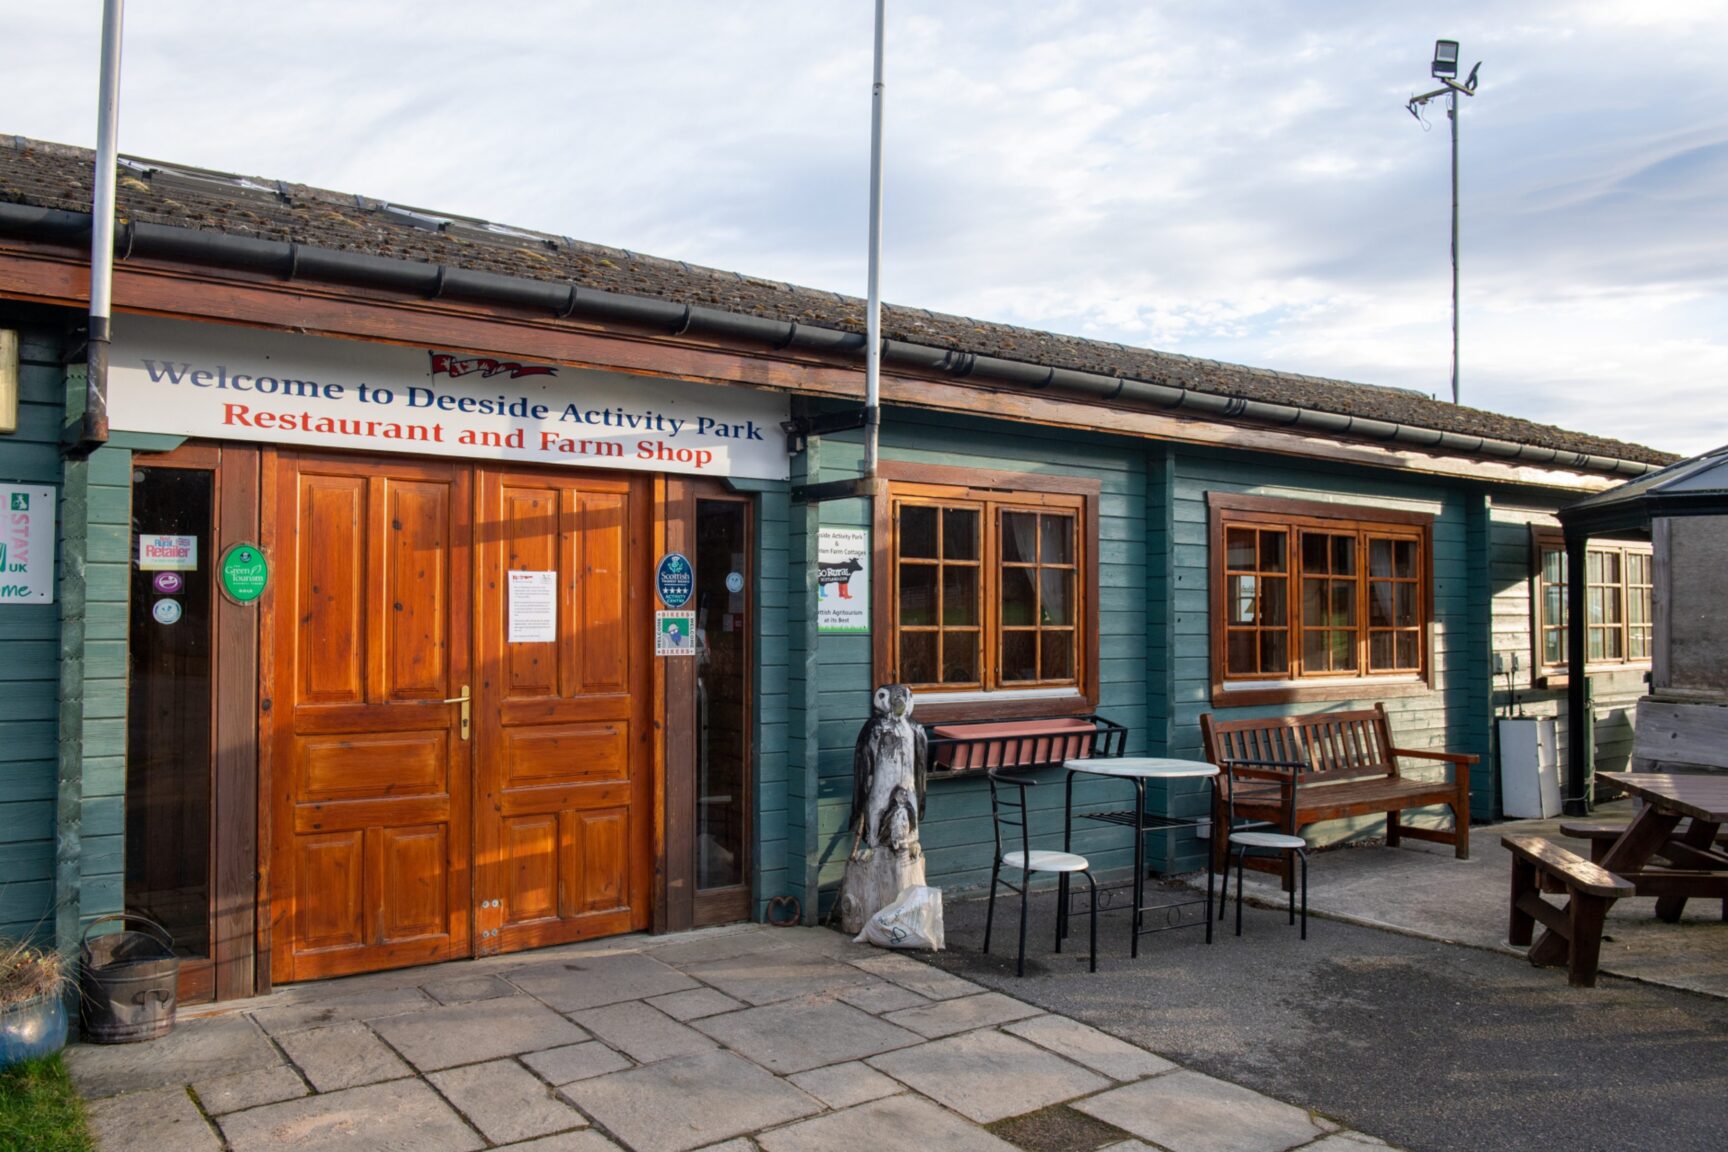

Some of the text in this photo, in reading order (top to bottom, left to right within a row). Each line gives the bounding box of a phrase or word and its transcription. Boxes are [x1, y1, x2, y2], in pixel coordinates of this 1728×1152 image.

[140, 358, 765, 442] Welcome to Deeside Activity Park
[221, 402, 713, 468] Restaurant and Farm Shop
[11, 513, 29, 563] STAY
[145, 544, 190, 558] Retailer
[9, 563, 28, 573] UK
[224, 565, 250, 575] Green
[232, 574, 264, 582] Tourism
[661, 571, 690, 580] Scottish
[0, 585, 32, 597] me
